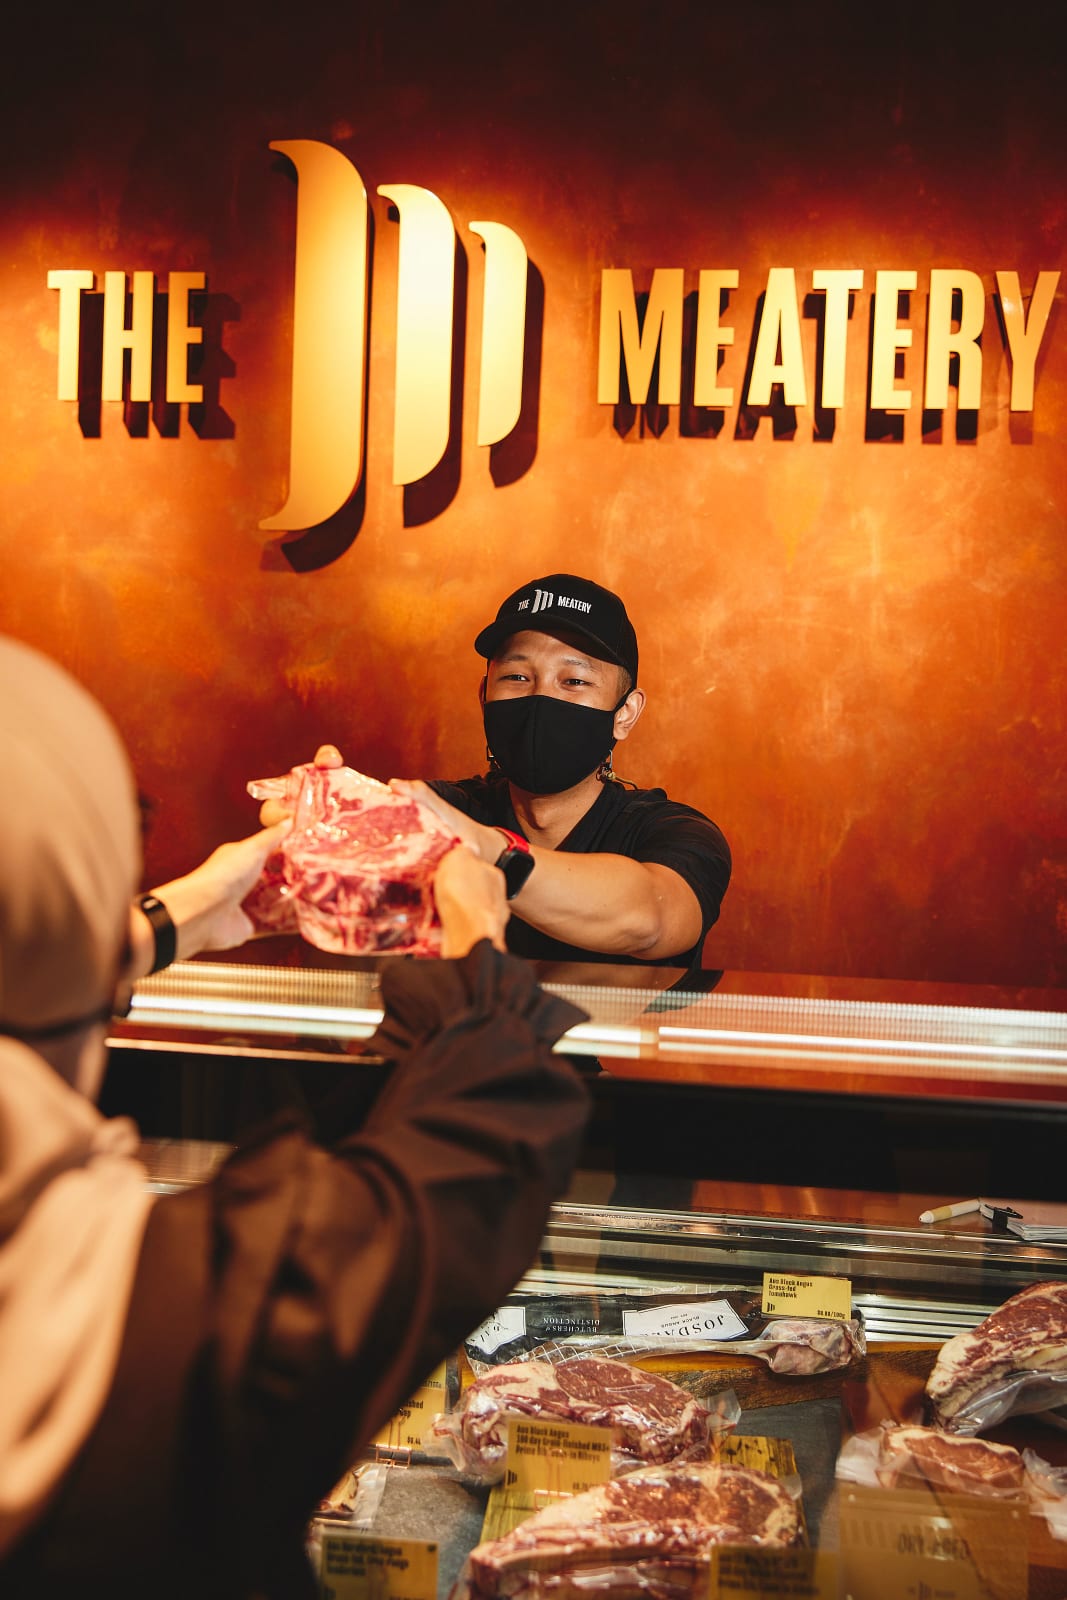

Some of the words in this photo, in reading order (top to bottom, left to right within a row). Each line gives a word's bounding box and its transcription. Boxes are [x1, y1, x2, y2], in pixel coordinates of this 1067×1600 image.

[47, 270, 206, 403] THE
[598, 268, 1061, 412] MEATERY
[518, 599, 531, 612] THE
[558, 596, 592, 614] MEATERY
[543, 1317, 600, 1326] DISTINCTION
[553, 1324, 597, 1333] BUTCHERS
